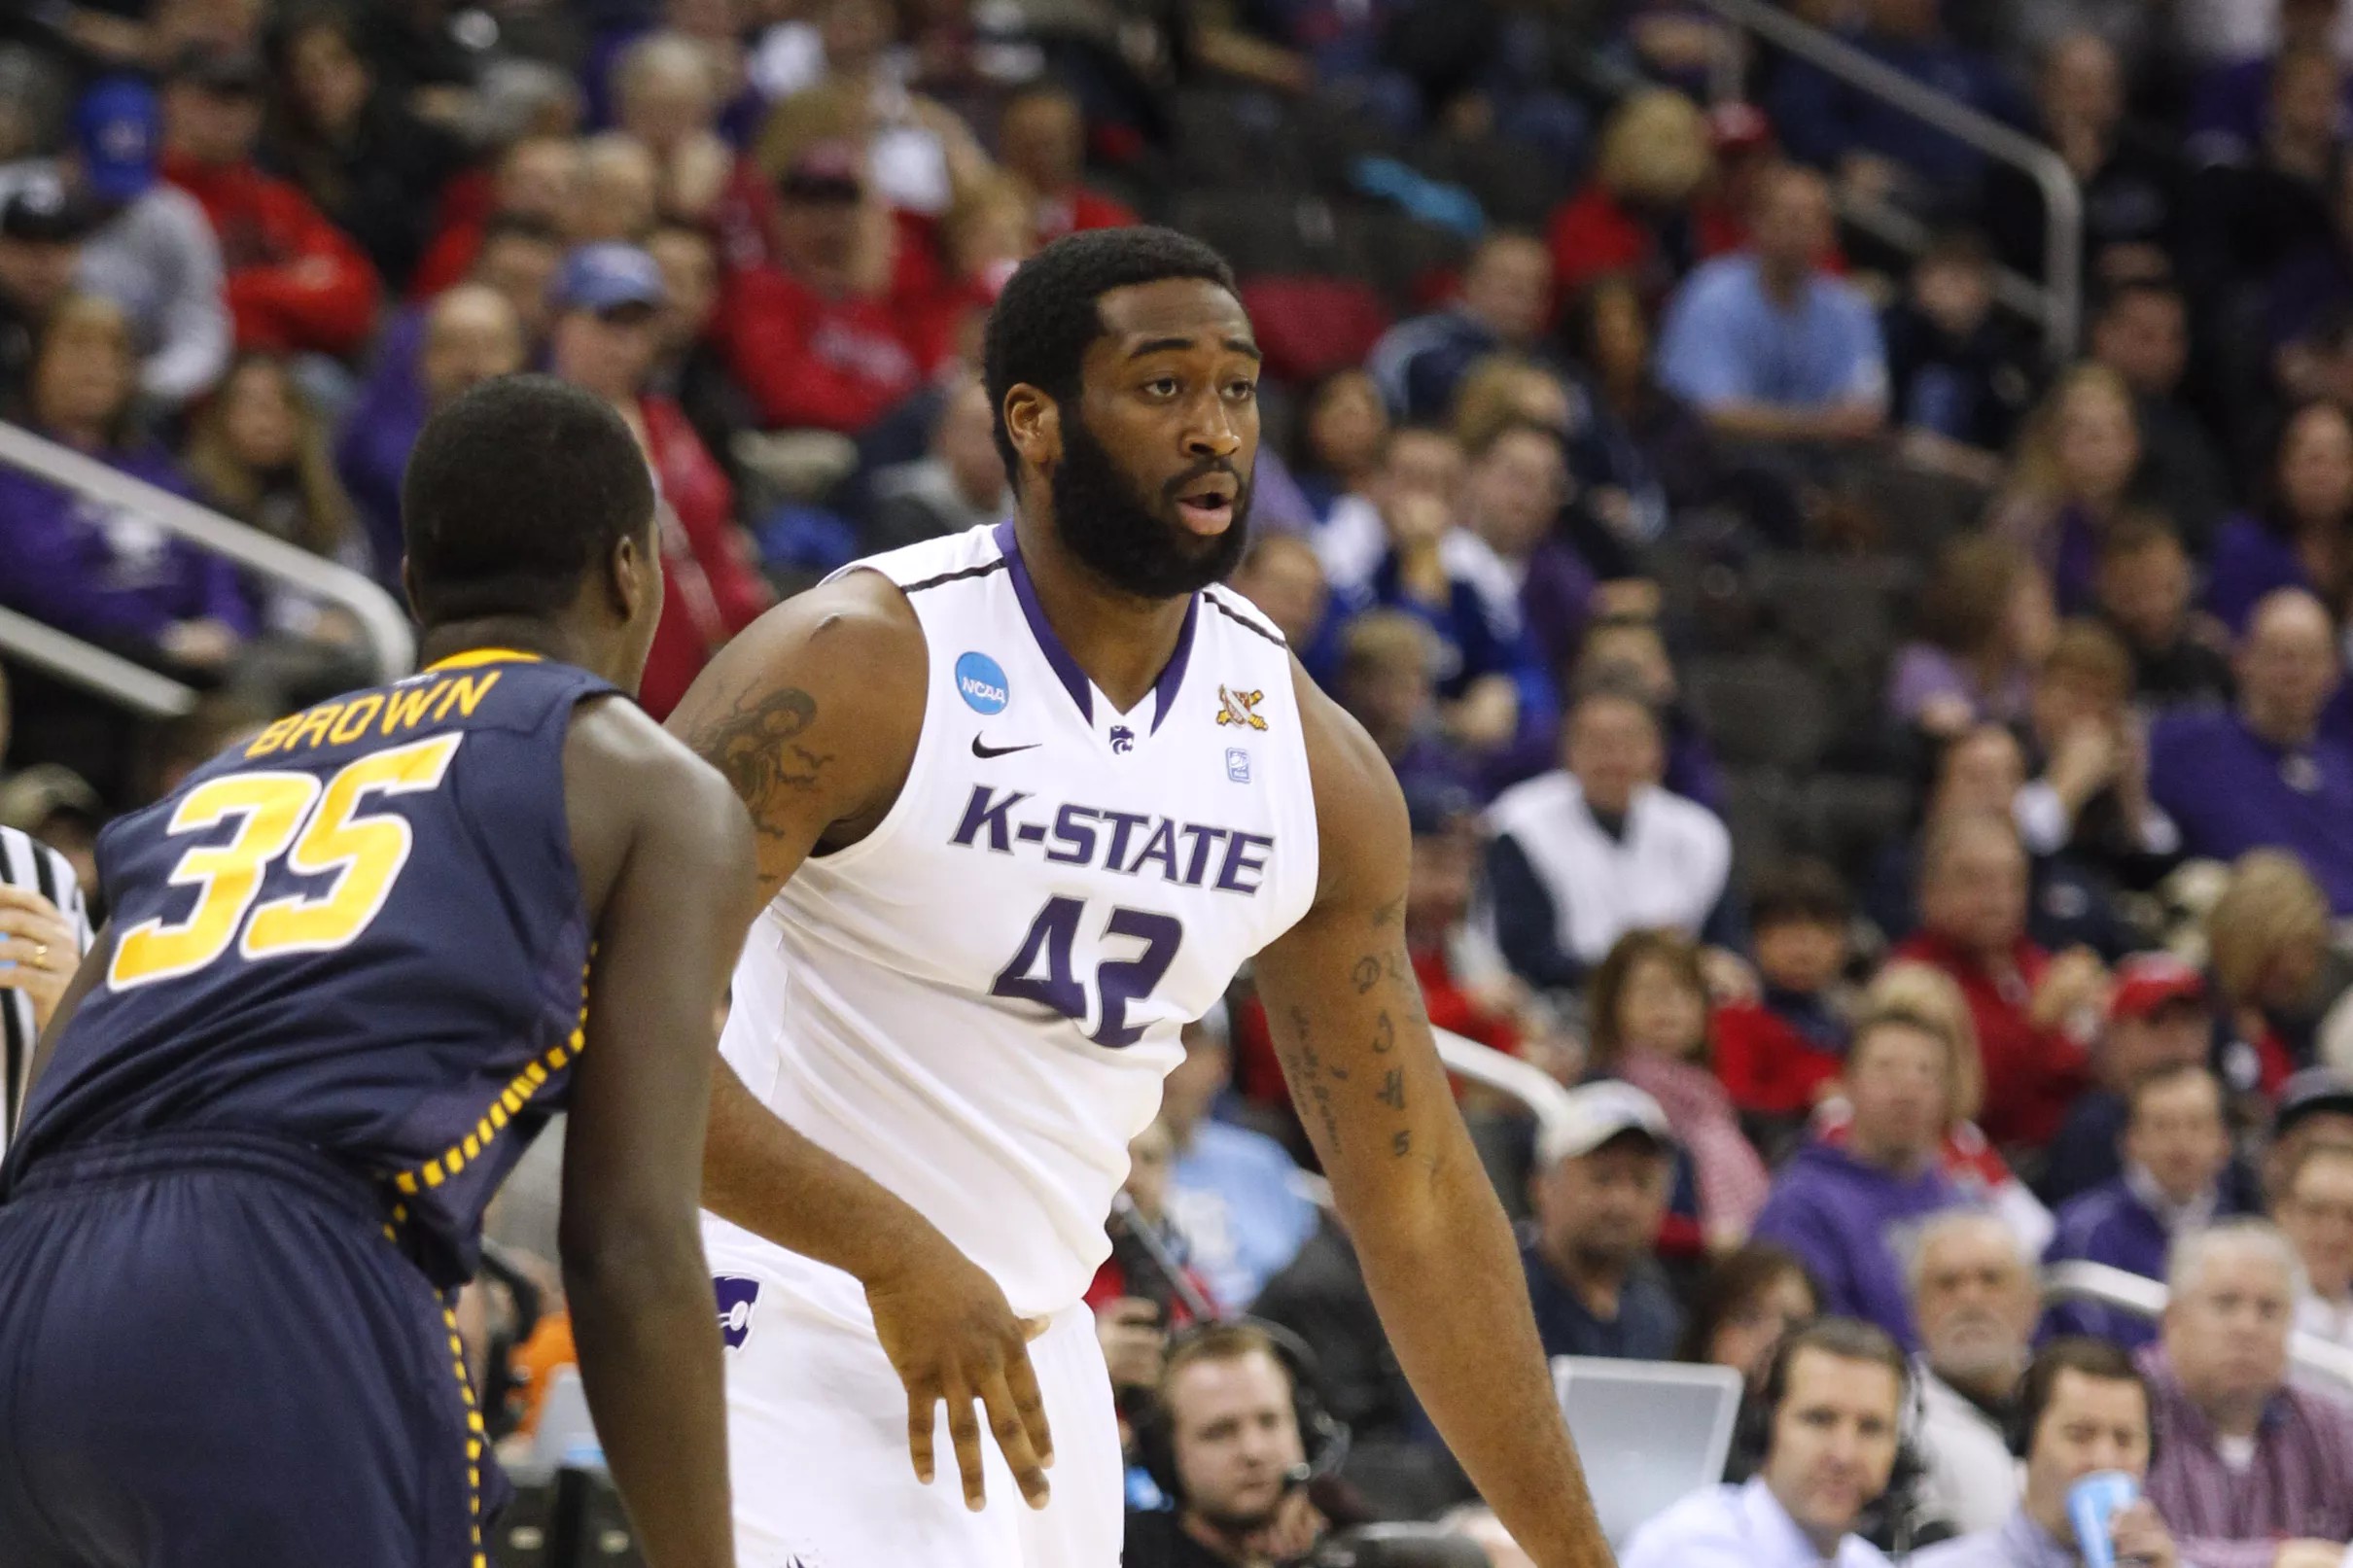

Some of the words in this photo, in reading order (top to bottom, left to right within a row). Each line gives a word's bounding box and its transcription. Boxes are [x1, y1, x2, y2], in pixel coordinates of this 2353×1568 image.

[244, 671, 502, 760] BROWN
[963, 676, 1005, 703] NCAA
[108, 731, 464, 993] 35
[948, 784, 1276, 896] K-STATE
[986, 892, 1182, 1050] 42
